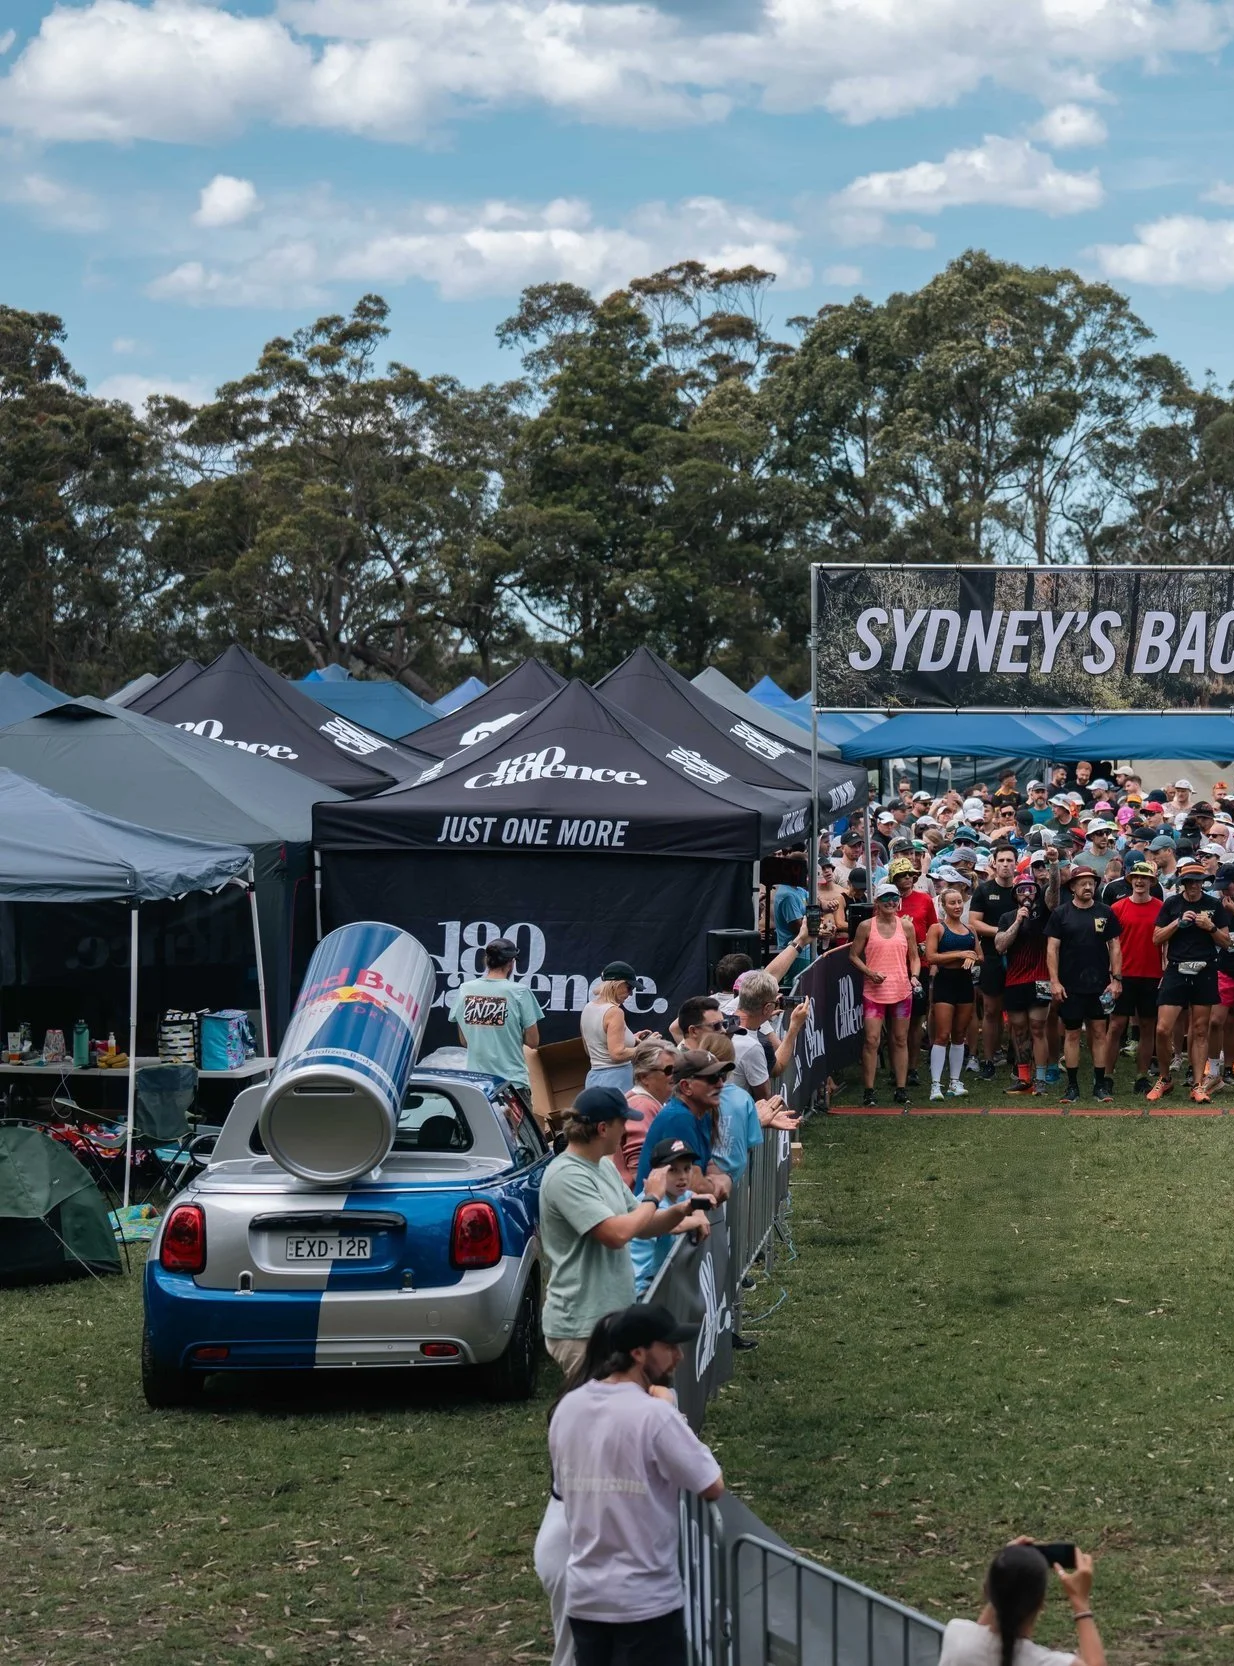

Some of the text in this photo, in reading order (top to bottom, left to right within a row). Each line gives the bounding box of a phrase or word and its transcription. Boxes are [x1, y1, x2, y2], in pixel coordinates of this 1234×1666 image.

[848, 607, 1122, 674] SYDNEY'S
[464, 762, 648, 789] Cadence.
[494, 746, 566, 781] 180
[437, 816, 629, 847] JUST ONE MORE
[356, 968, 420, 1022] Bull
[350, 1052, 373, 1067] Body
